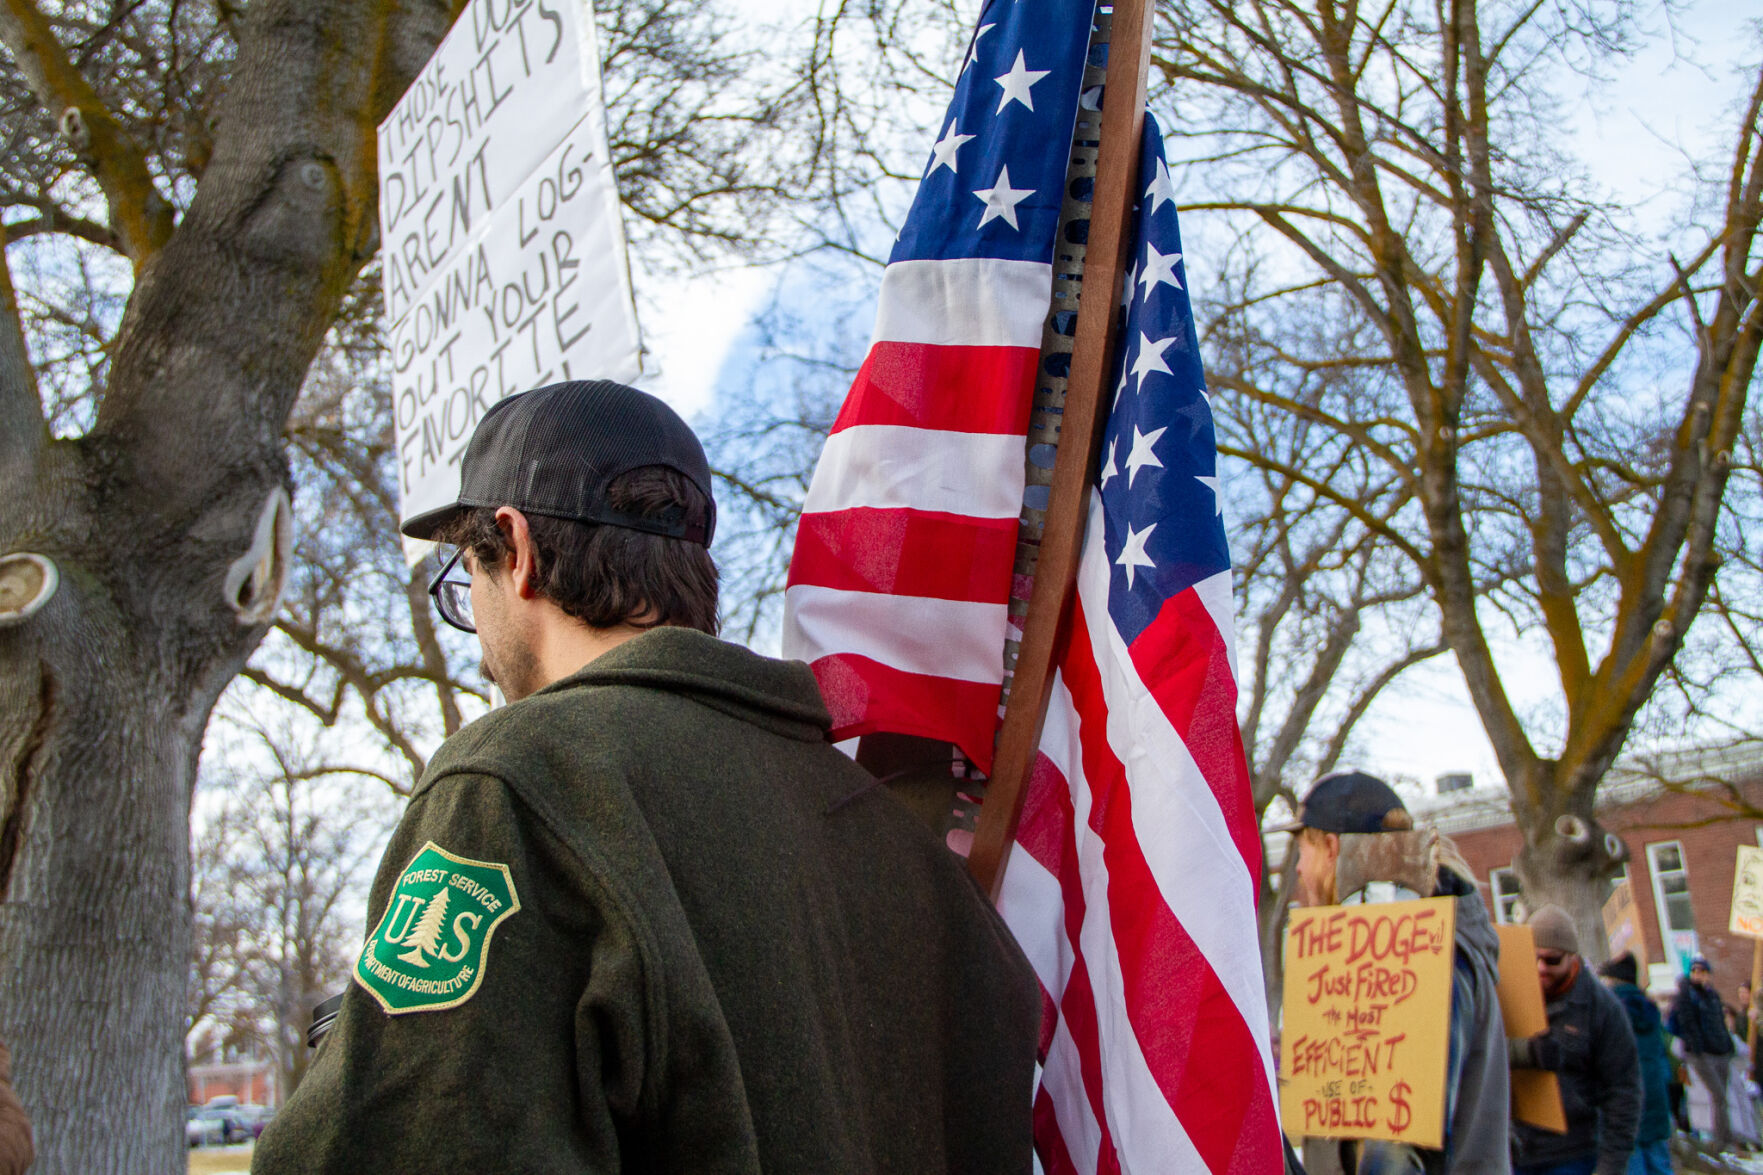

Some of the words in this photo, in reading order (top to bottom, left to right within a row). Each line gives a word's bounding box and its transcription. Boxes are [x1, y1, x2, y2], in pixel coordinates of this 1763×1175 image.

[382, 56, 449, 164] THOSE
[386, 0, 563, 233] DIPSHITS
[390, 136, 492, 322] ARENT
[394, 243, 493, 373] GONNA
[519, 143, 593, 249] LOG-
[398, 330, 461, 431] OUT
[484, 230, 580, 343] YOUR
[401, 272, 592, 496] FAVORITE
[402, 869, 449, 888] FOREST
[448, 873, 502, 913] SERVICE
[1291, 911, 1347, 958] THE
[397, 973, 412, 989] OF
[407, 964, 475, 995] AGRICULTURE
[1302, 1095, 1379, 1130] PUBLIC
[1387, 1078, 1412, 1136] $
